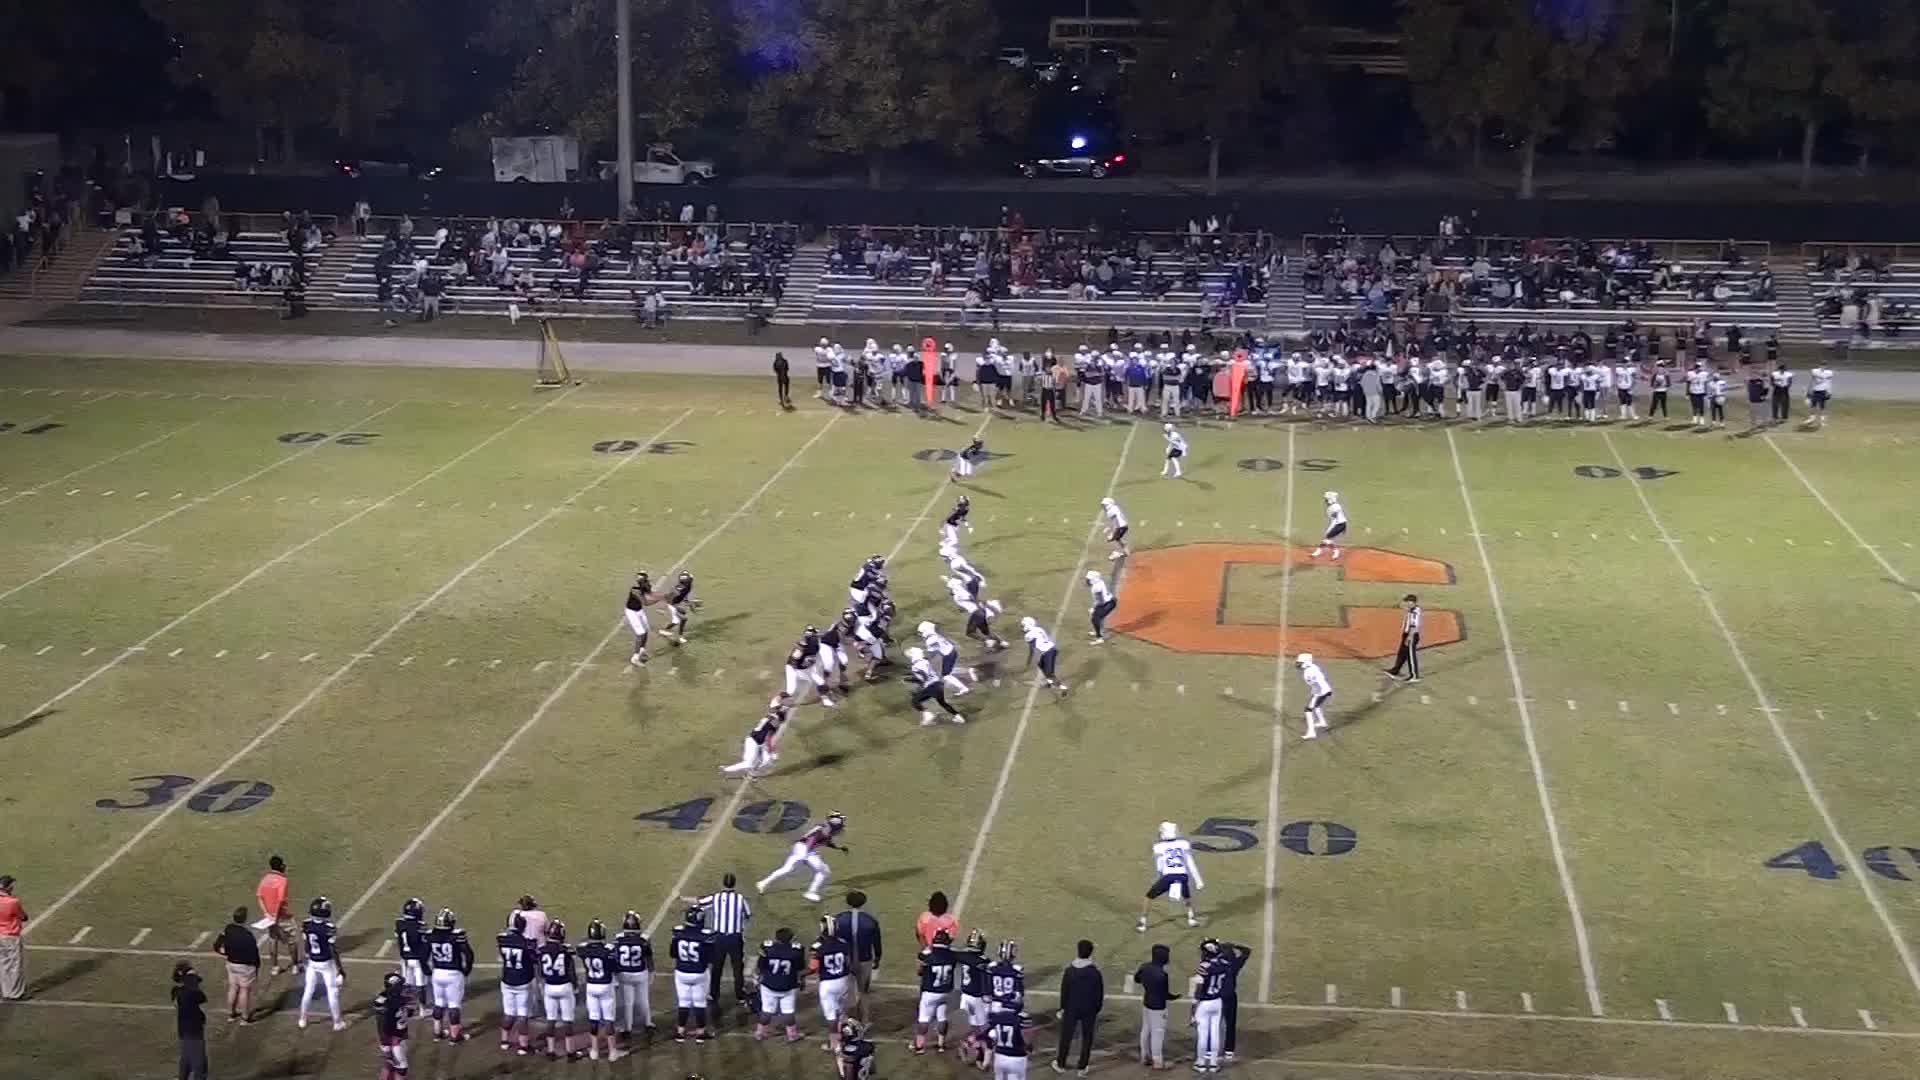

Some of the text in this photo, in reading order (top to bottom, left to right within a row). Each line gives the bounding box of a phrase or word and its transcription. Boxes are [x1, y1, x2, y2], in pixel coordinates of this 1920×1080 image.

[1236, 457, 1340, 473] 50
[1573, 463, 1681, 482] 40
[1112, 542, 1466, 657] C
[95, 774, 275, 814] 30
[634, 795, 811, 834] 40
[1190, 816, 1358, 857] 50
[1762, 839, 1920, 884] 40
[432, 942, 454, 963] 59
[619, 945, 642, 968] 22
[677, 940, 700, 962] 65
[541, 953, 566, 976] 24
[993, 1024, 1015, 1048] 17
